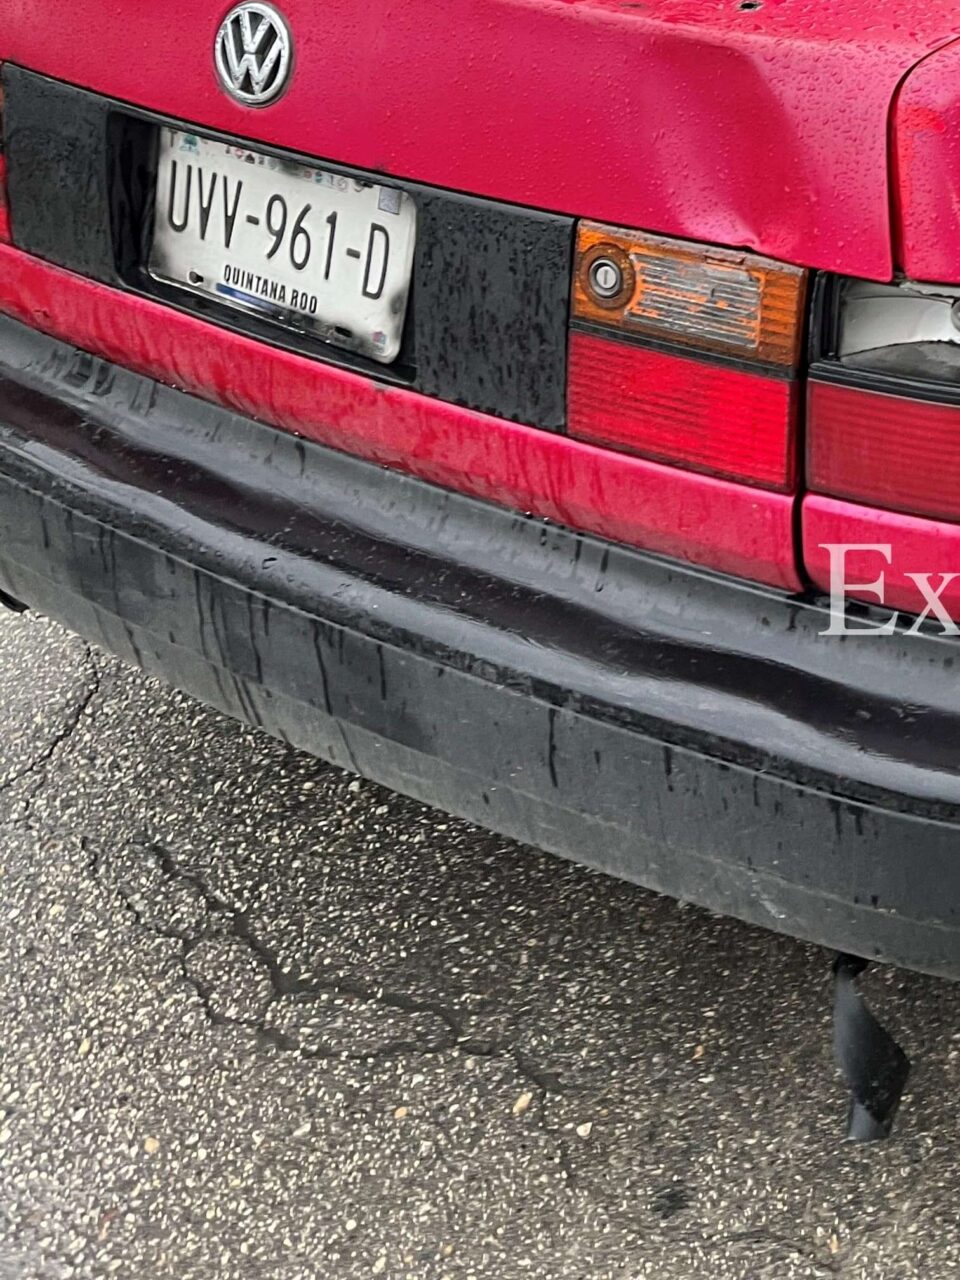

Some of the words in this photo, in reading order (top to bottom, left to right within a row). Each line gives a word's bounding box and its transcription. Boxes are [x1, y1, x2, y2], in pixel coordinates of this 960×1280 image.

[168, 159, 390, 300] UVV-961-D
[223, 264, 286, 303] QUINTANA
[290, 288, 318, 315] ROO
